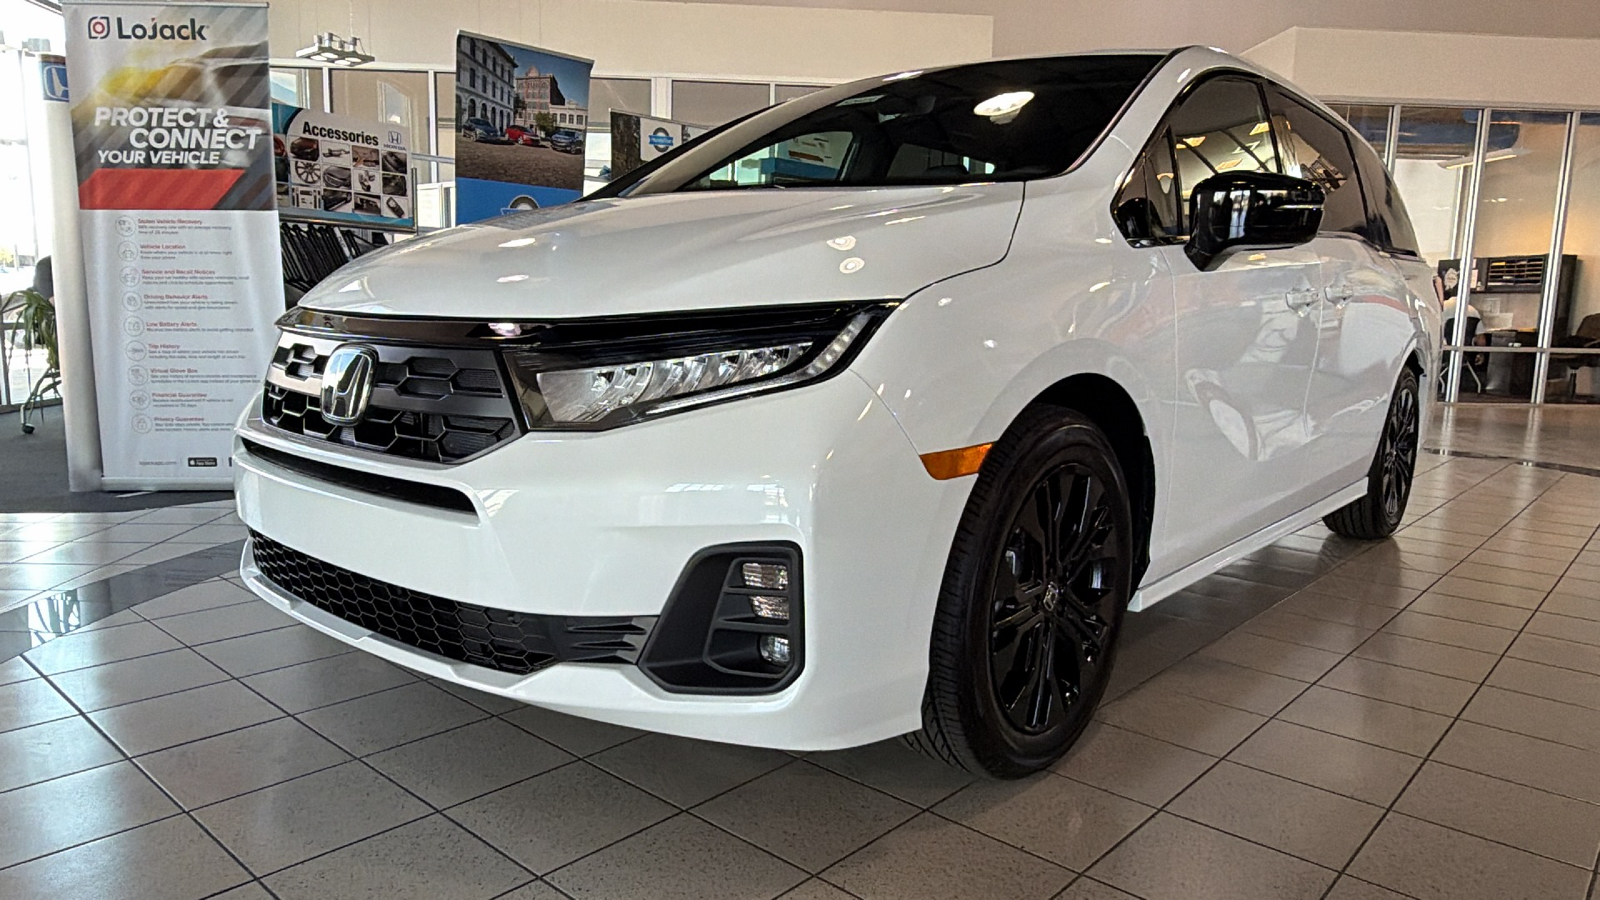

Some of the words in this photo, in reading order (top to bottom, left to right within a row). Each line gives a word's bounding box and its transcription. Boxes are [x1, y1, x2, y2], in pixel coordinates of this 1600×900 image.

[94, 107, 213, 128] PROTECT
[129, 128, 262, 150] CONNECT
[302, 121, 379, 146] Accessories
[97, 150, 147, 164] YOUR
[150, 150, 221, 165] VEHICLE
